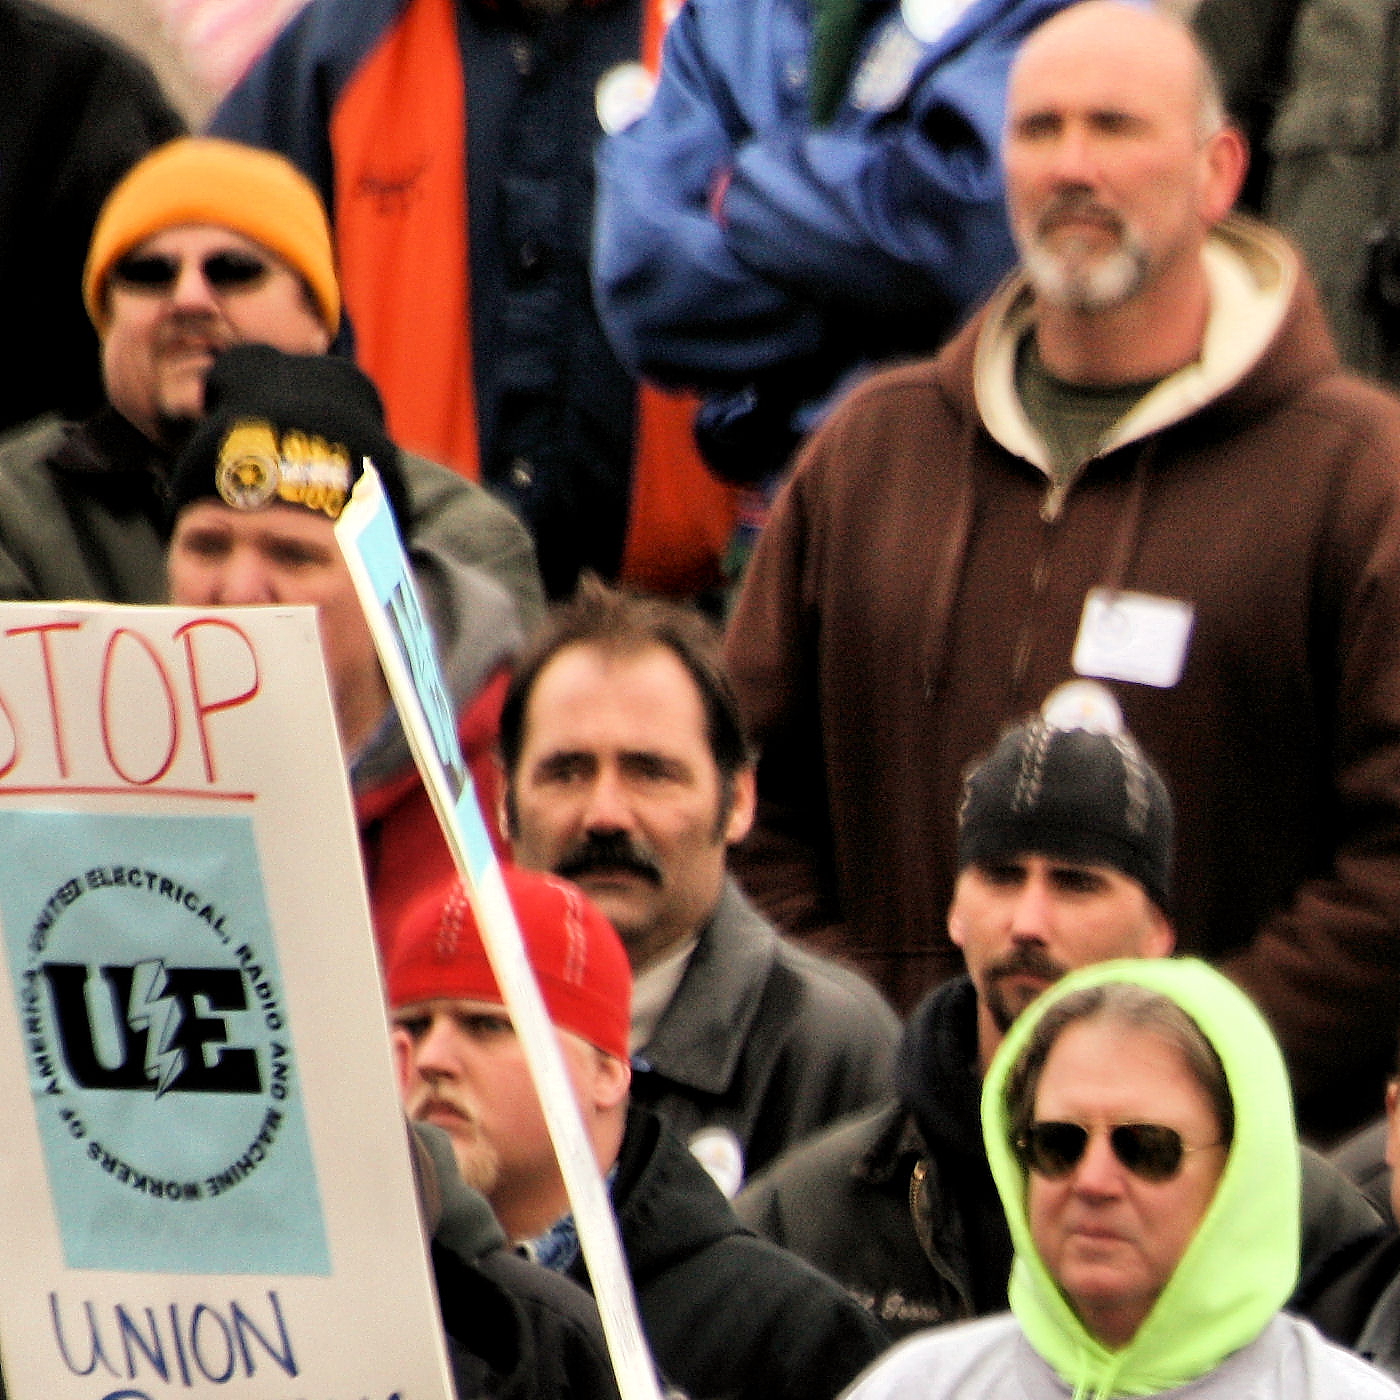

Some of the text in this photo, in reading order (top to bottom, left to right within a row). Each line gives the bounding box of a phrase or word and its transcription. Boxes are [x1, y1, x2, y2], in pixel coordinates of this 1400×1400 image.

[0, 617, 262, 786] TOP
[42, 961, 262, 1097] UE
[234, 943, 284, 1033] RADIO
[268, 1040, 288, 1101] AND
[205, 1105, 284, 1198] MACHINE
[49, 1291, 300, 1389] UNION
